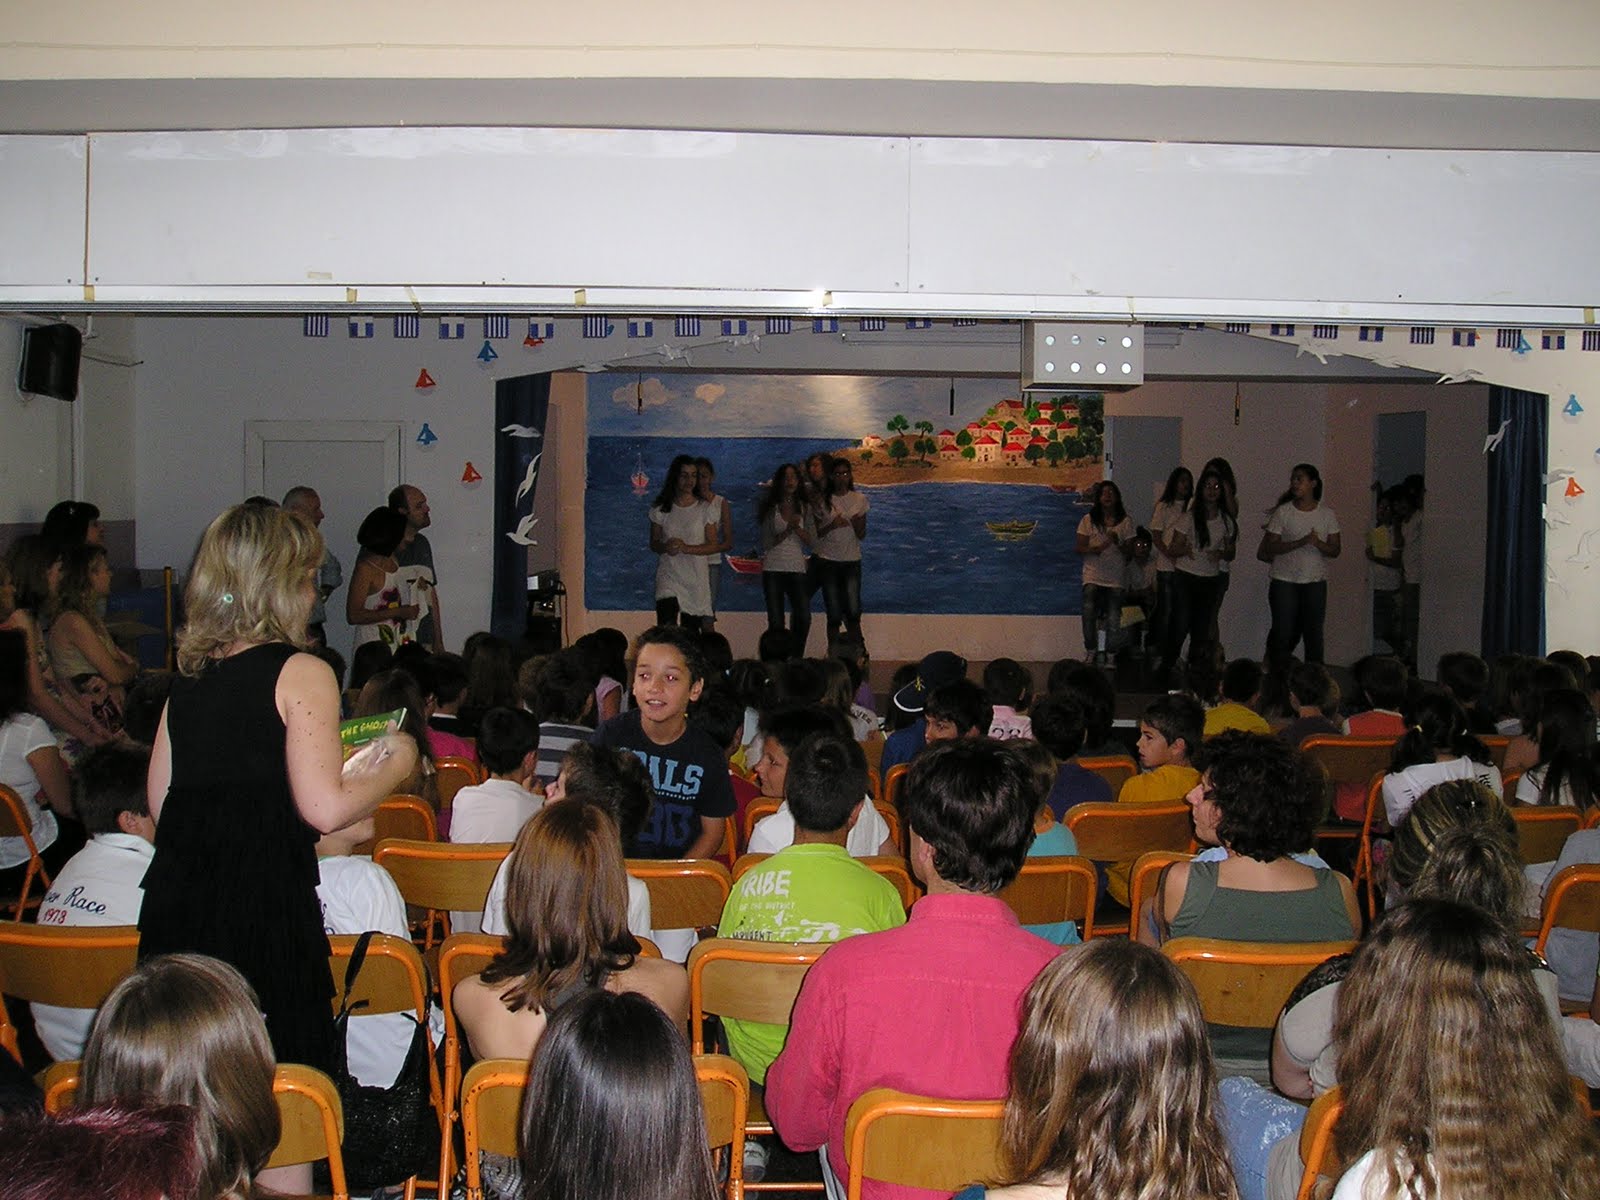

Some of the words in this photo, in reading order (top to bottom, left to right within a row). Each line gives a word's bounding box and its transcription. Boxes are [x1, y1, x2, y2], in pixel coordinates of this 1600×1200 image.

[341, 725, 359, 739] THE
[634, 750, 704, 795] ALS
[63, 886, 107, 916] Race
